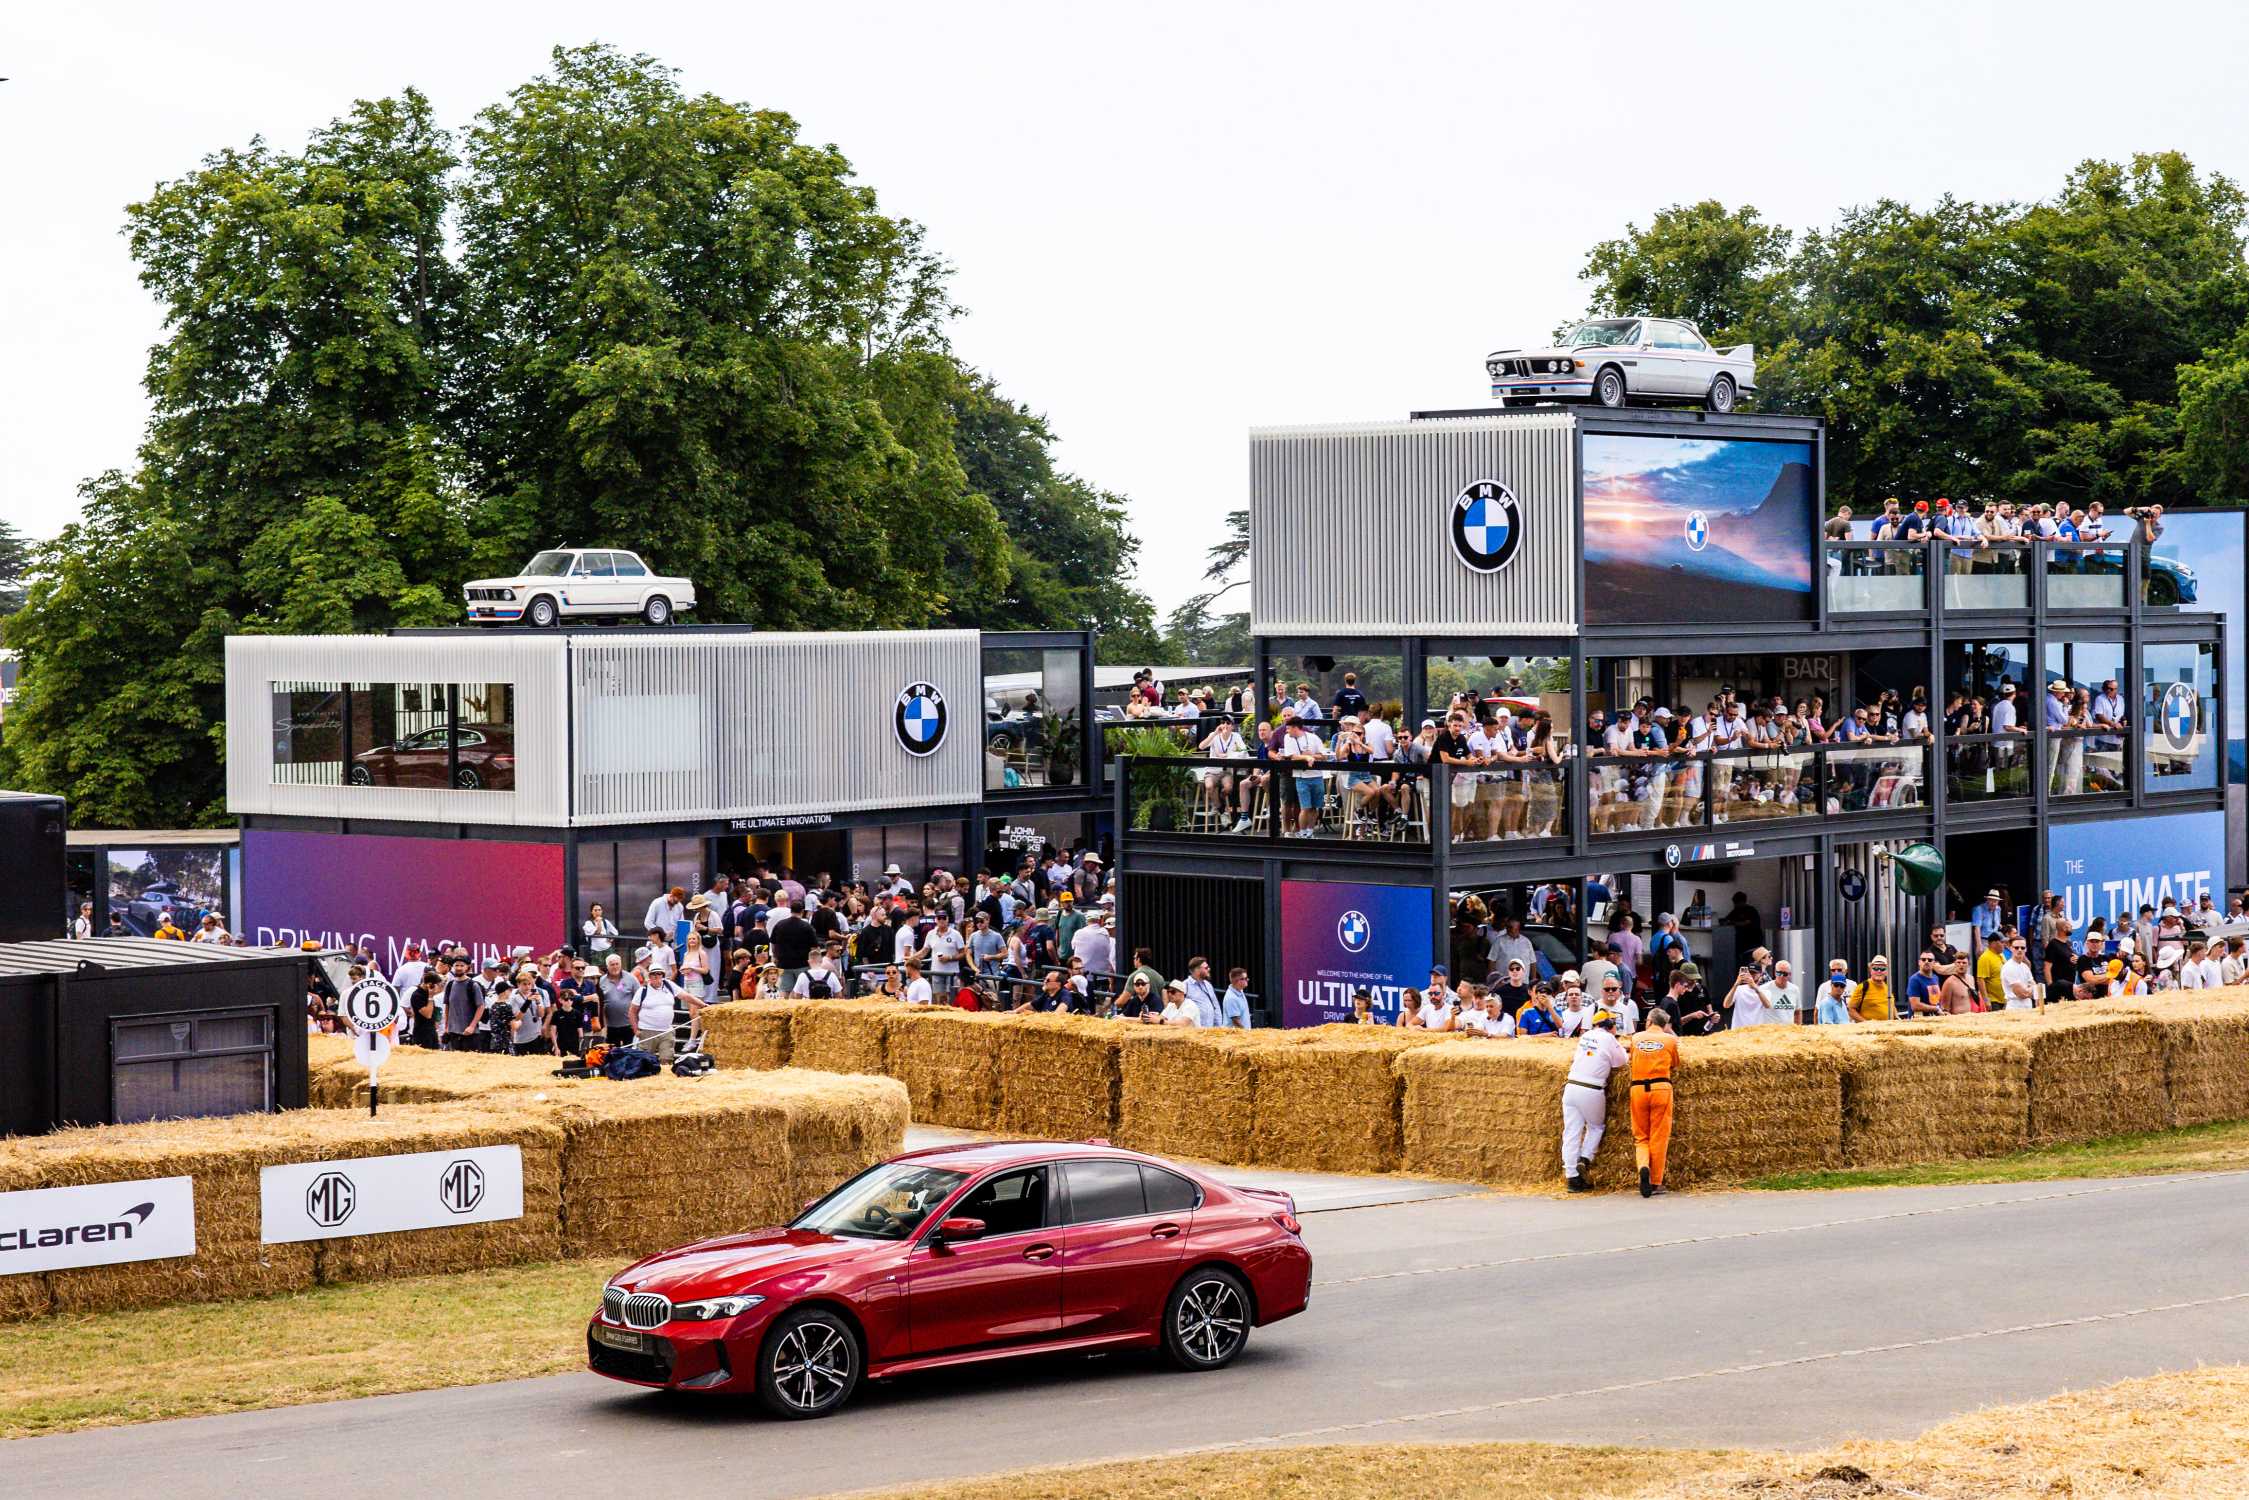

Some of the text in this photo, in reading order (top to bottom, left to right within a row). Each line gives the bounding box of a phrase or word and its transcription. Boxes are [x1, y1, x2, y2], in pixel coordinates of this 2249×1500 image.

[1459, 484, 1514, 511] BMW
[1784, 657, 1829, 679] BAR
[901, 685, 942, 706] BMW
[731, 814, 832, 829] THE ULTIMATE INNOVATION
[1010, 826, 1035, 836] JOHN
[2064, 859, 2085, 875] THE
[1317, 969, 1341, 977] WELCOME
[358, 980, 387, 990] TRACK
[366, 991, 380, 1019] 6
[352, 1014, 394, 1030] CROSSING
[444, 1164, 480, 1209] MG
[311, 1177, 351, 1222] MG
